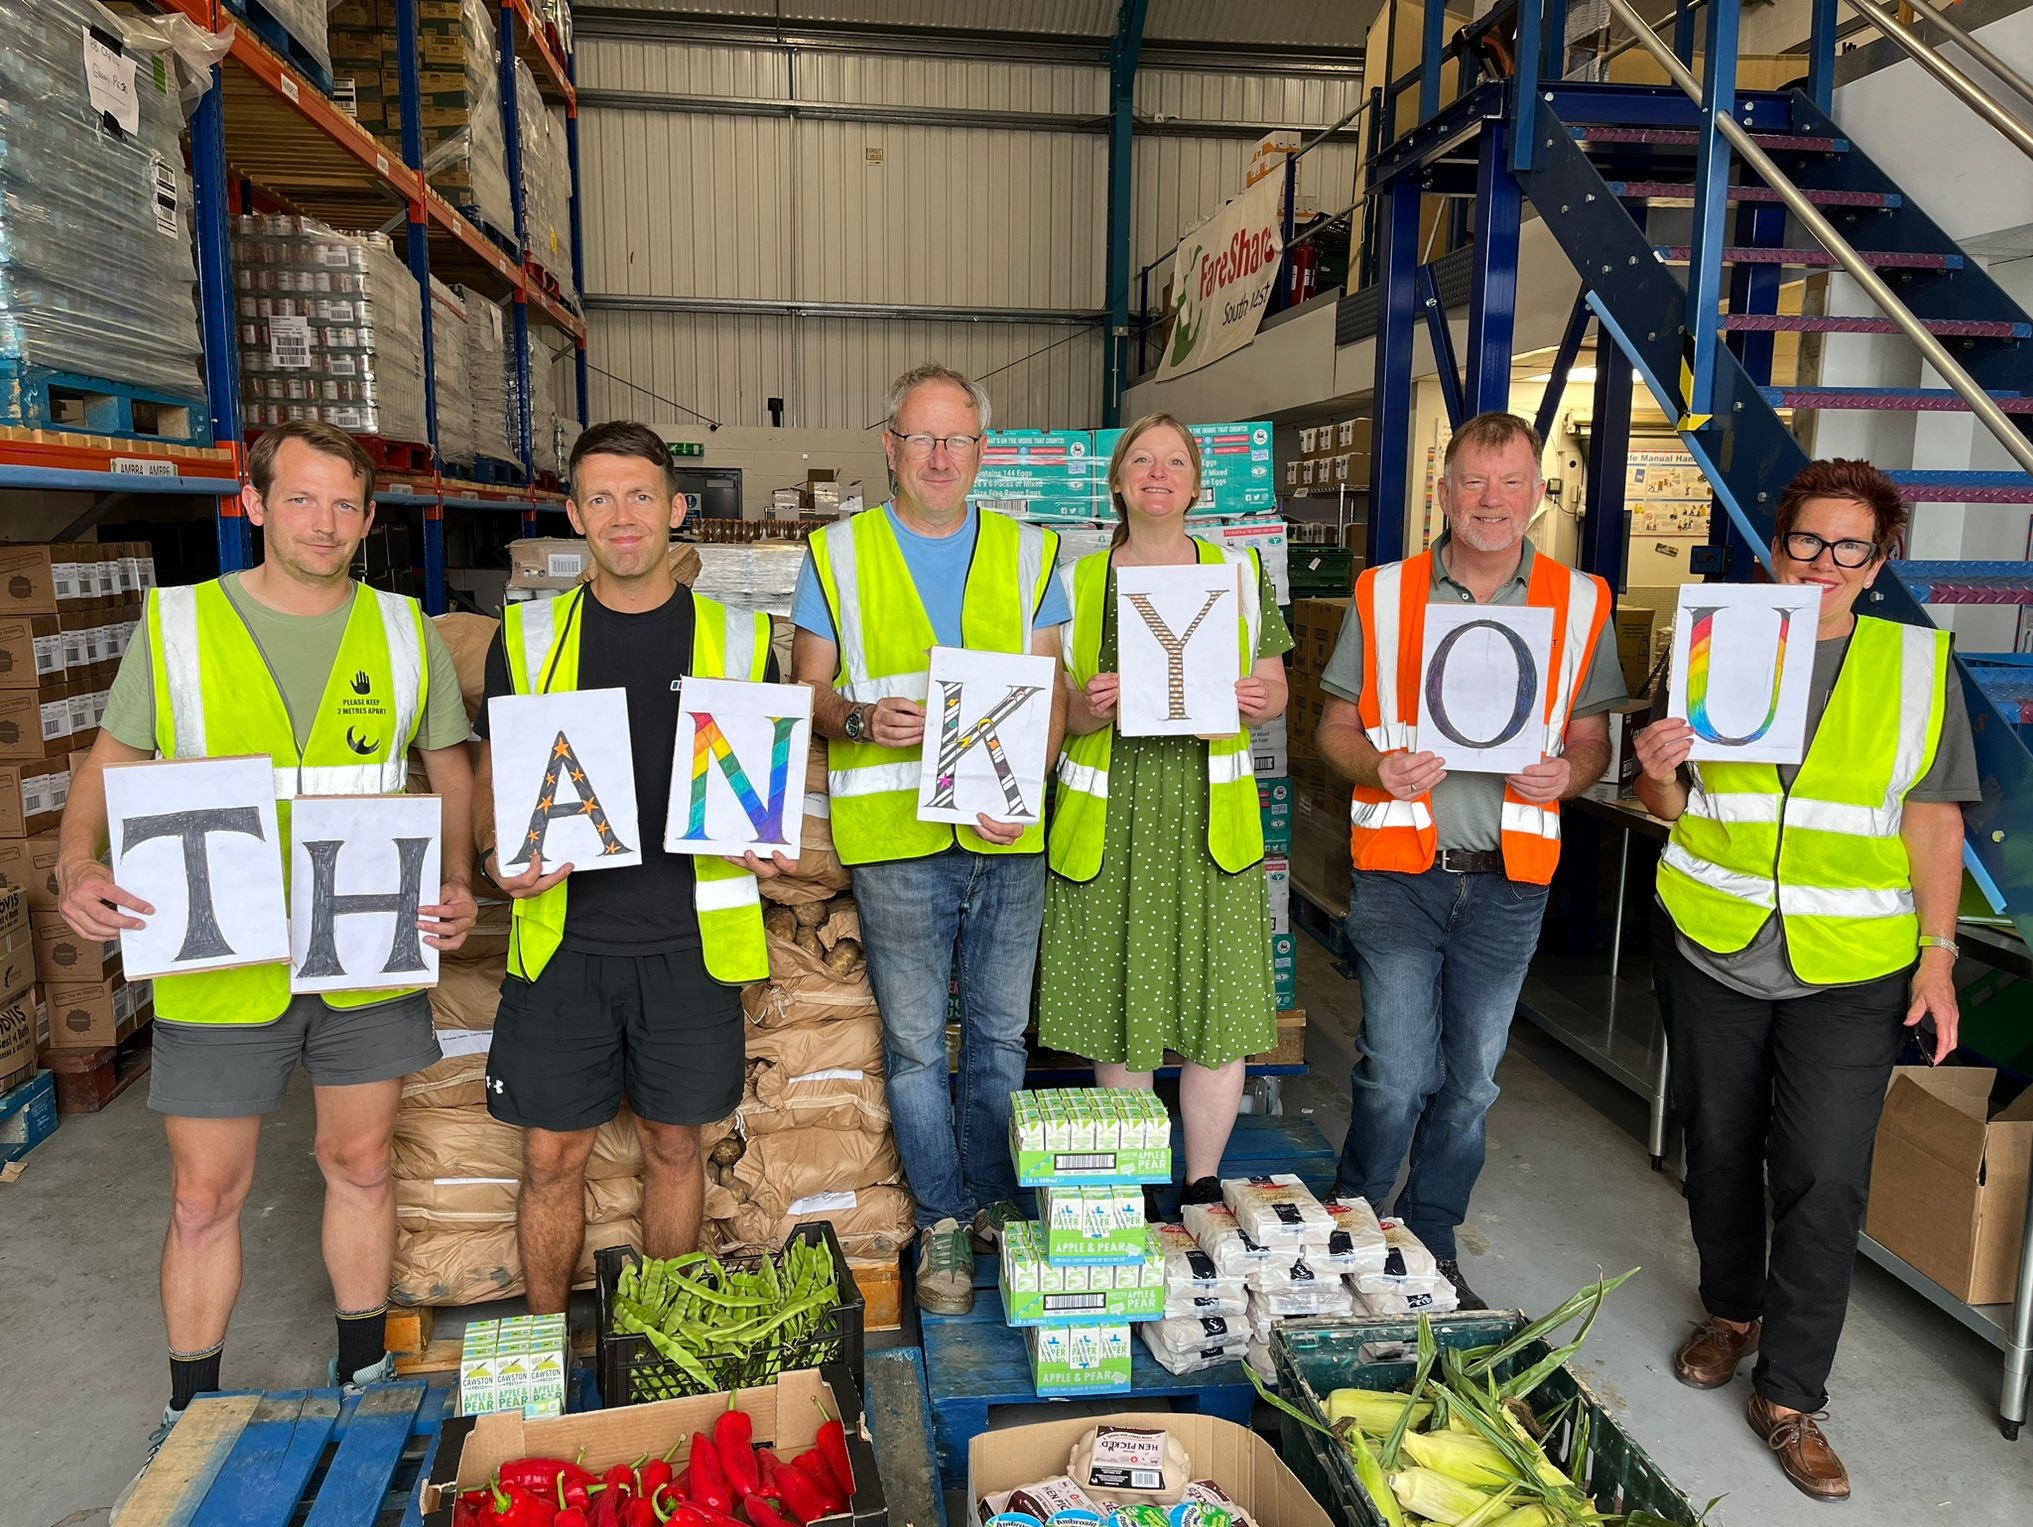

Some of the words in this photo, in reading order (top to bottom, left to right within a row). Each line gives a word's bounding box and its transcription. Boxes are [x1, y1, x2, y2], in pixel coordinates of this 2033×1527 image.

[1222, 292, 1249, 326] South
[1640, 454, 1673, 463] Manual
[1003, 469, 1015, 477] 144
[1016, 470, 1033, 479] Eggs
[1208, 468, 1228, 476] Mixed
[1211, 477, 1226, 487] Eggs
[1120, 589, 1230, 721] Y
[1683, 605, 1804, 747] U
[1426, 619, 1538, 749] O
[337, 707, 342, 715] 2
[342, 707, 367, 715] METRES
[367, 707, 387, 715] APART
[923, 679, 1046, 818] K
[675, 711, 805, 845] N
[505, 730, 635, 866] A
[119, 806, 267, 963] T
[0, 892, 19, 914] OVIS
[296, 837, 433, 979] H
[0, 1004, 26, 1035] OVIS
[1138, 1151, 1160, 1160] APPLE
[1160, 1151, 1166, 1159] &
[1138, 1160, 1166, 1169] PEAR
[1056, 1242, 1085, 1253] APPLE
[1087, 1242, 1095, 1253] &
[1097, 1241, 1127, 1252] PEAR
[1127, 1290, 1149, 1299] APPLE
[1127, 1299, 1156, 1308] PEAR
[497, 1372, 527, 1383] CAWSTON
[531, 1369, 561, 1380] CAWSTON
[1043, 1373, 1072, 1384] APPLE
[1074, 1371, 1081, 1383] &
[1084, 1370, 1112, 1381] PEAR
[463, 1377, 493, 1387] CAWSTON
[499, 1388, 520, 1399] APPLE
[521, 1387, 527, 1395] &
[533, 1384, 554, 1395] APPLE
[555, 1383, 561, 1392] &
[465, 1392, 487, 1403] APPLE
[487, 1391, 493, 1400] &
[499, 1396, 528, 1409] PEAR
[464, 1400, 494, 1412] PEAR
[1101, 1440, 1136, 1451] PICKED
[1138, 1443, 1158, 1451] HEN
[1042, 1486, 1060, 1502] HEN
[1054, 1499, 1071, 1512] PIC
